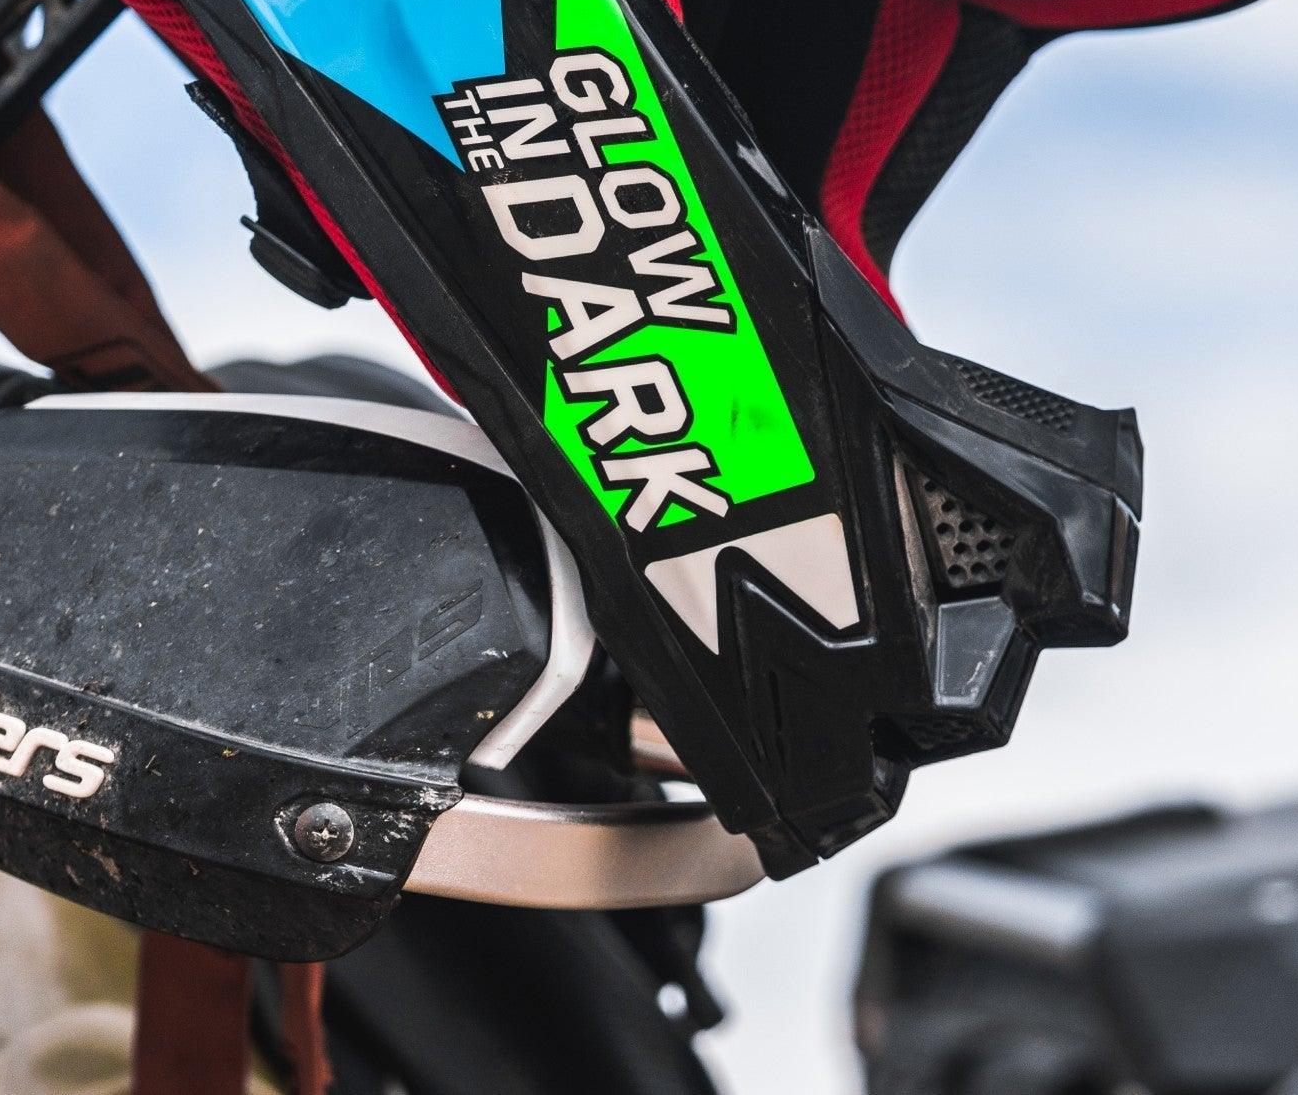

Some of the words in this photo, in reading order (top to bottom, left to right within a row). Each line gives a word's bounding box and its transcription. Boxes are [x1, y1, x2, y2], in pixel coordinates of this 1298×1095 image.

[443, 89, 505, 173] THE
[475, 77, 571, 162] IN
[548, 52, 732, 325] GLOW
[480, 174, 729, 533] DARK
